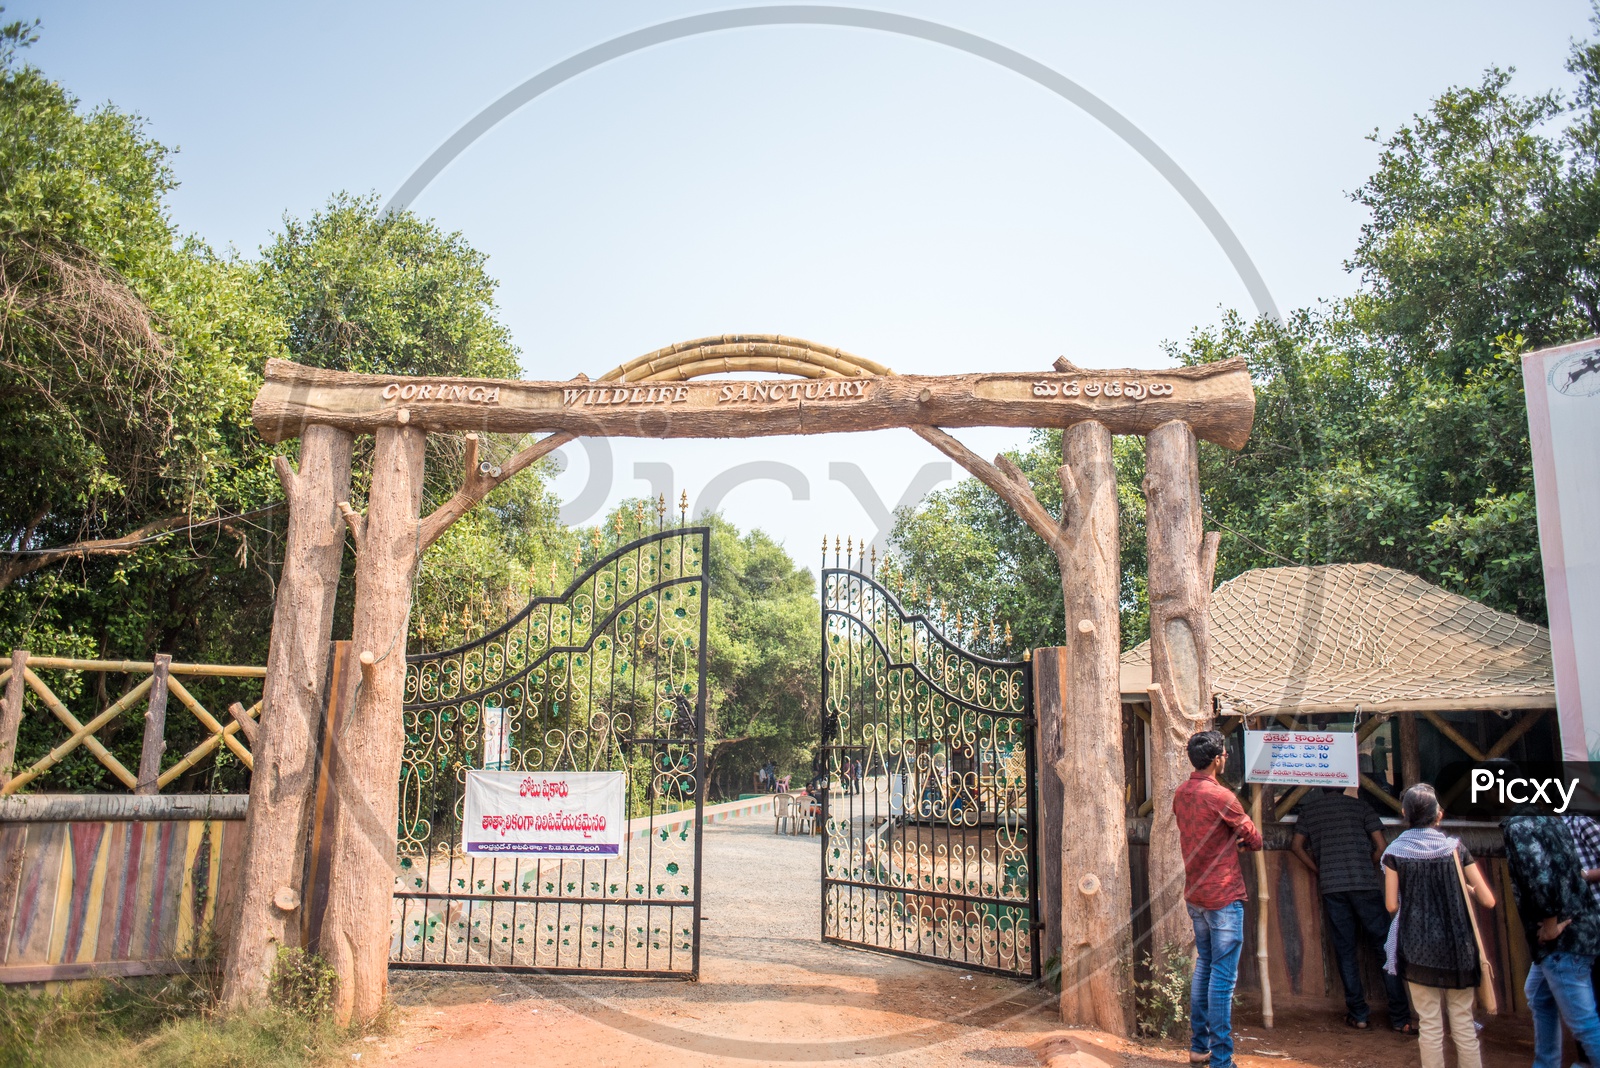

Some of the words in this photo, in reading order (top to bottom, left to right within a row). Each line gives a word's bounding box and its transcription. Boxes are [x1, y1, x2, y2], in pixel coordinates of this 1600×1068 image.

[381, 383, 500, 403] CORINGA
[562, 387, 690, 405] WILDLIFE
[719, 380, 870, 402] SANCTUARY
[482, 813, 535, 837] తాత్కాలికంగా
[535, 810, 607, 838] నిలిపివేయడమైనది
